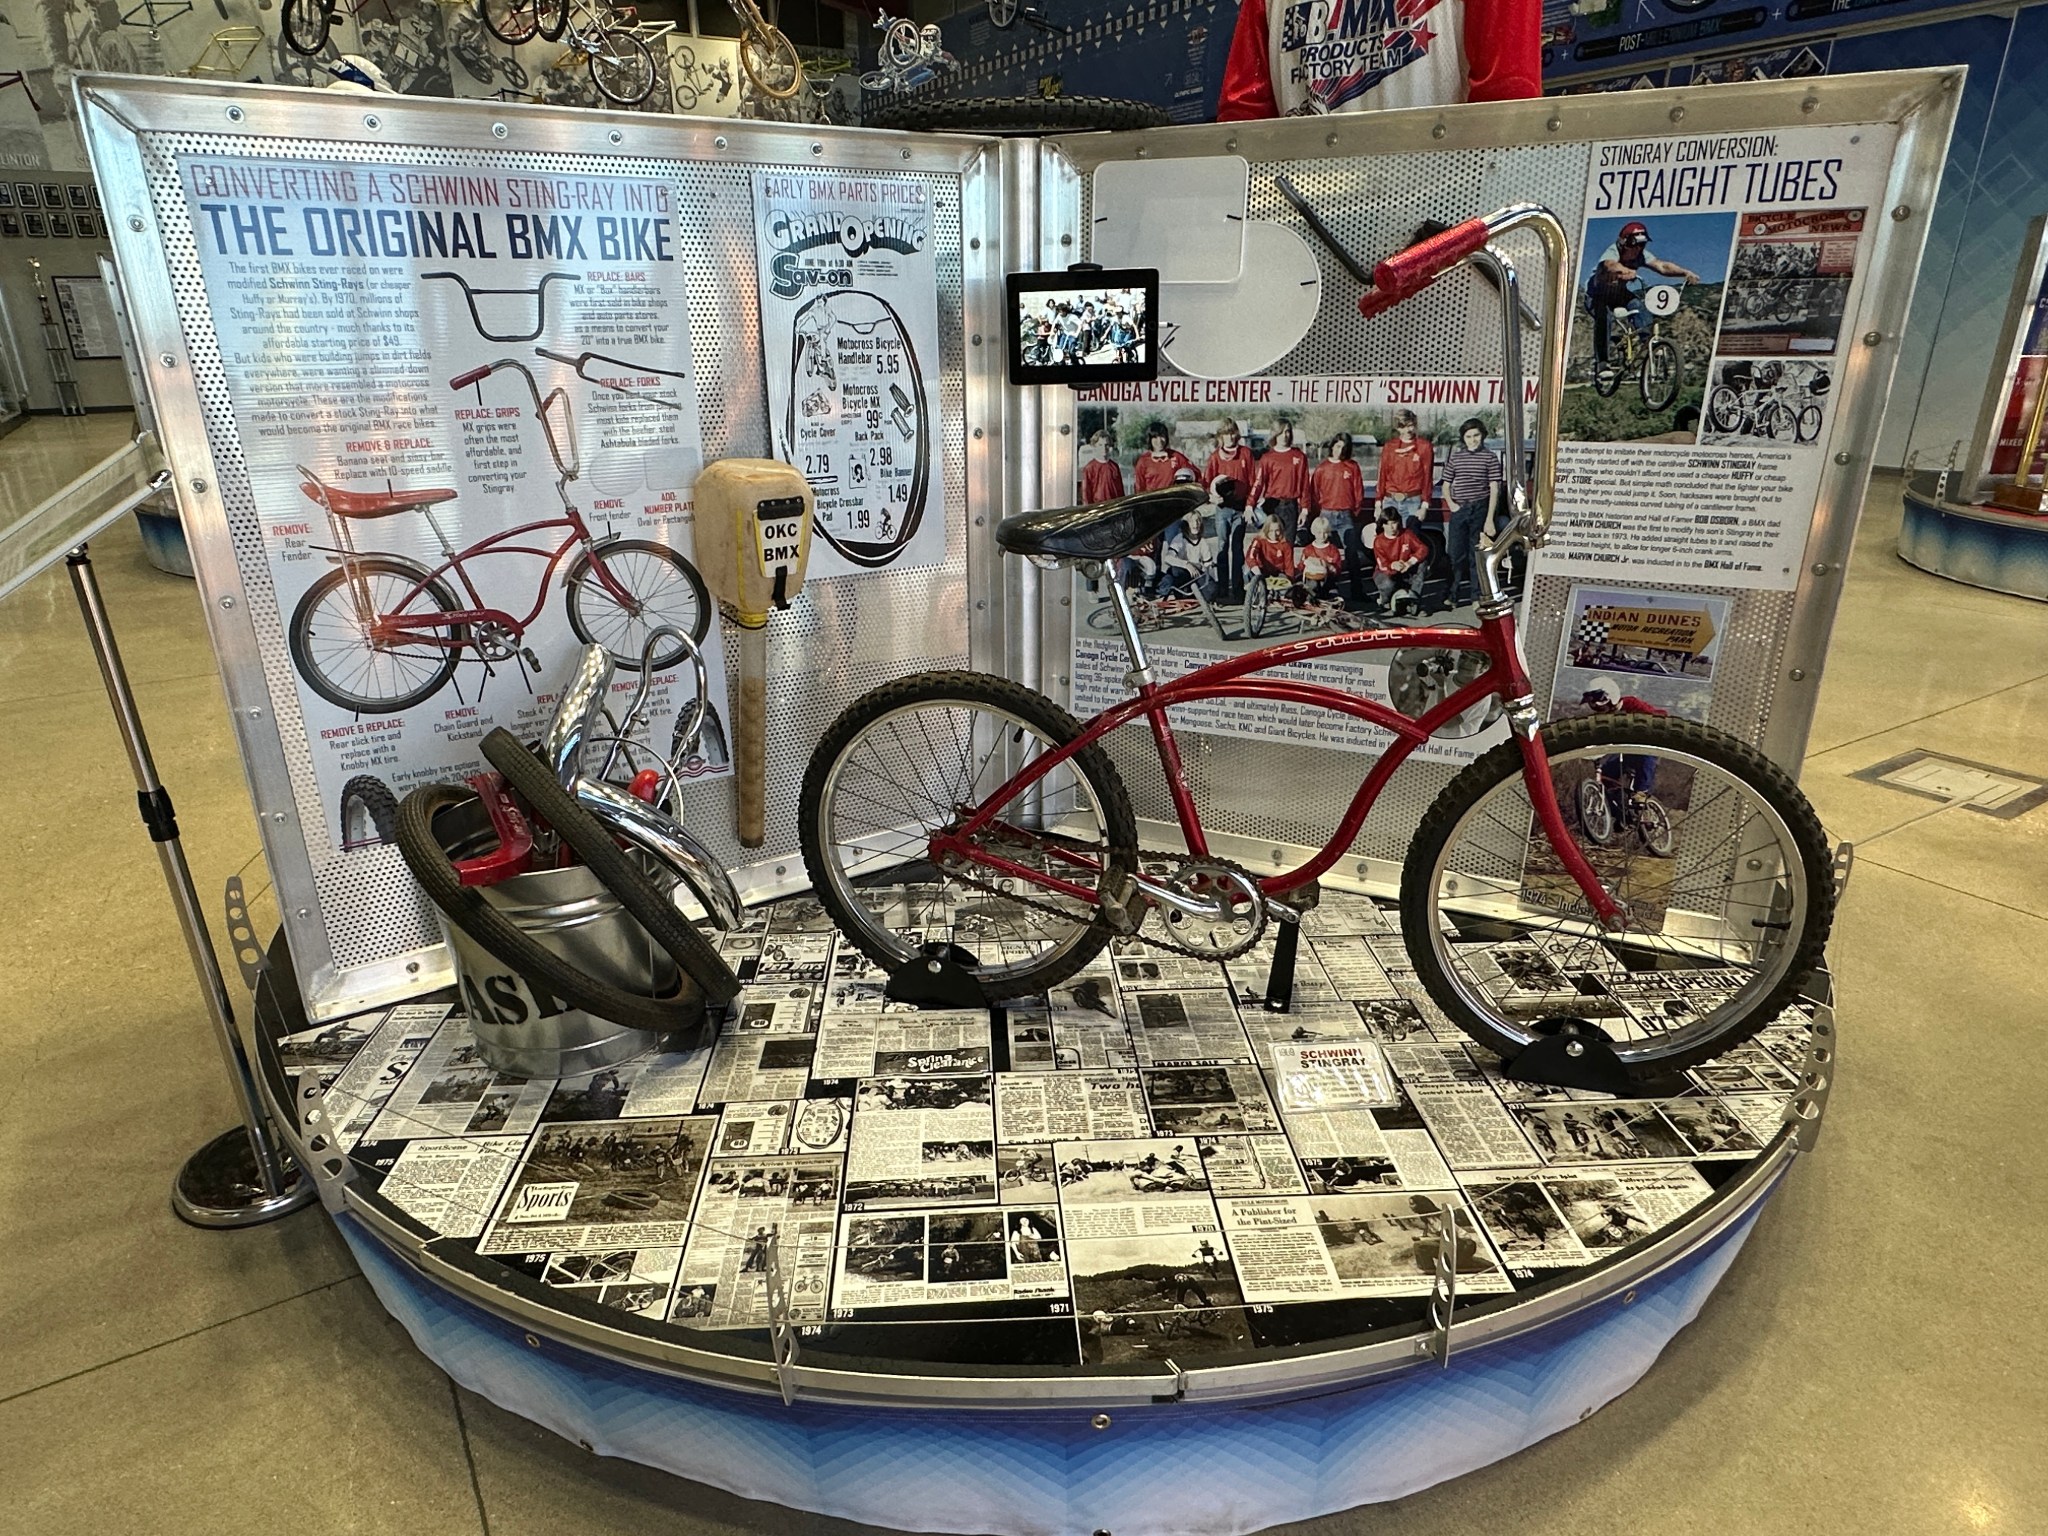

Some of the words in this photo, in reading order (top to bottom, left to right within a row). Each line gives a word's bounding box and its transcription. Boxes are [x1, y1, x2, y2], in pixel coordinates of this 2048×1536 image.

[1300, 33, 1384, 62] PRODUCTS
[1291, 58, 1355, 85] FACTORY
[1360, 50, 1403, 73] TEAM
[1600, 142, 1674, 167] STINGRAY
[1675, 135, 1779, 163] CONVERSION:
[190, 164, 358, 202] CONVERTING
[368, 172, 384, 203] A
[389, 173, 500, 207] SCHWINN
[506, 178, 615, 211] STING-RAY
[623, 183, 669, 213] INTO
[765, 177, 804, 199] EARLY
[808, 179, 836, 201] BMX
[839, 181, 877, 202] PARTS
[881, 183, 925, 205] PRICES
[1595, 164, 1738, 210] STRAIGHT
[1745, 158, 1843, 204] TUBES
[200, 203, 294, 256] THE
[302, 207, 497, 259] ORIGINAL
[506, 213, 588, 260] BMX
[596, 216, 674, 262] BIKE
[764, 208, 846, 251] GRAND
[840, 215, 927, 256] OPENING
[1808, 222, 1852, 232] NEWS
[228, 261, 247, 274] The
[248, 261, 269, 274] first
[271, 261, 292, 275] BMX
[292, 261, 317, 274] bikes
[320, 266, 339, 275] ever
[341, 263, 367, 275] raced
[369, 266, 380, 275] on
[381, 266, 404, 275] were
[624, 271, 646, 282] BARS
[227, 277, 268, 289] modified
[269, 277, 311, 289] Schwinn
[312, 277, 364, 292] Sting-Rays
[1656, 290, 1670, 310] 9
[837, 337, 873, 350] Motocross
[875, 336, 901, 352] Bicycle
[838, 352, 873, 365] Handlebar
[876, 354, 900, 375] 5.95
[636, 376, 661, 387] FORKS
[843, 383, 879, 396] Motocross
[1148, 380, 1200, 403] CYCLE
[1206, 380, 1271, 403] CENTER
[1290, 380, 1319, 403] THE
[1326, 380, 1374, 403] FIRST
[842, 396, 868, 412] Bicycle
[870, 396, 881, 408] MX
[454, 408, 494, 420] REPLACE:
[495, 407, 521, 418] GRIPS
[462, 421, 475, 432] MX
[476, 422, 497, 434] grips
[498, 422, 517, 431] were
[800, 428, 818, 441] Cycle
[819, 427, 836, 438] Cover
[464, 434, 484, 446] often
[486, 433, 499, 444] the
[500, 433, 519, 443] most
[855, 431, 869, 442] Back
[870, 430, 884, 441] Pack
[346, 440, 383, 453] REMOVE
[508, 444, 522, 455] and
[869, 446, 893, 467] 2.98
[473, 459, 491, 470] first
[492, 459, 509, 470] step
[510, 459, 518, 468] in
[805, 453, 830, 475] 2.79
[1687, 458, 1720, 469] SCHWINN
[1721, 459, 1757, 470] STINGRAY
[468, 471, 509, 483] converting
[509, 471, 527, 482] your
[880, 467, 893, 478] Bike
[894, 467, 913, 477] Banner
[1731, 471, 1755, 480] HUFFY
[887, 483, 909, 503] 1.49
[643, 502, 673, 515] NUMBER
[816, 499, 838, 511] Bicycle
[839, 496, 864, 508] Crossbar
[822, 511, 834, 522] Pad
[847, 509, 870, 530] 1.99
[272, 523, 313, 536] REMOVE:
[764, 522, 798, 540] OKC
[1569, 519, 1593, 529] MARVIN
[1594, 520, 1622, 530] CHURCH
[284, 537, 307, 549] Rear
[763, 544, 800, 562] BMX
[1586, 609, 1640, 624] INDIAN
[1646, 612, 1702, 628] DUNES
[1610, 623, 1639, 633] MOTOR
[1640, 626, 1698, 638] RECREATION
[1281, 630, 1404, 657] Schwinn
[1665, 635, 1694, 645] PARK
[445, 706, 480, 720] REMOVE:
[320, 725, 356, 740] REMOVE
[358, 723, 365, 734] &
[366, 717, 406, 734] REPLACE:
[434, 721, 455, 734] Chain
[456, 718, 480, 731] Guard
[480, 714, 494, 726] and
[329, 739, 350, 751] Rear
[351, 735, 370, 748] slick
[371, 733, 386, 744] tire
[387, 731, 402, 742] and
[340, 747, 371, 761] replace
[372, 744, 391, 756] with
[340, 759, 370, 772] Knobby
[371, 756, 383, 767] MX
[1300, 1048, 1363, 1060] SCHWINN
[919, 1054, 984, 1073] Clearance
[1301, 1057, 1366, 1069] STINGRAY
[517, 1184, 573, 1213] Sports
[844, 1203, 864, 1212] 1972
[1232, 1208, 1239, 1217] A
[1240, 1206, 1281, 1217] Publisher
[1284, 1206, 1297, 1215] for
[1237, 1217, 1252, 1227] the
[1252, 1215, 1298, 1226] Pint-Sized
[524, 1253, 546, 1264] 1975
[1512, 1268, 1535, 1279] 1974
[833, 1307, 855, 1319] 1973
[1050, 1303, 1070, 1314] 1971
[800, 1325, 823, 1337] 1974
